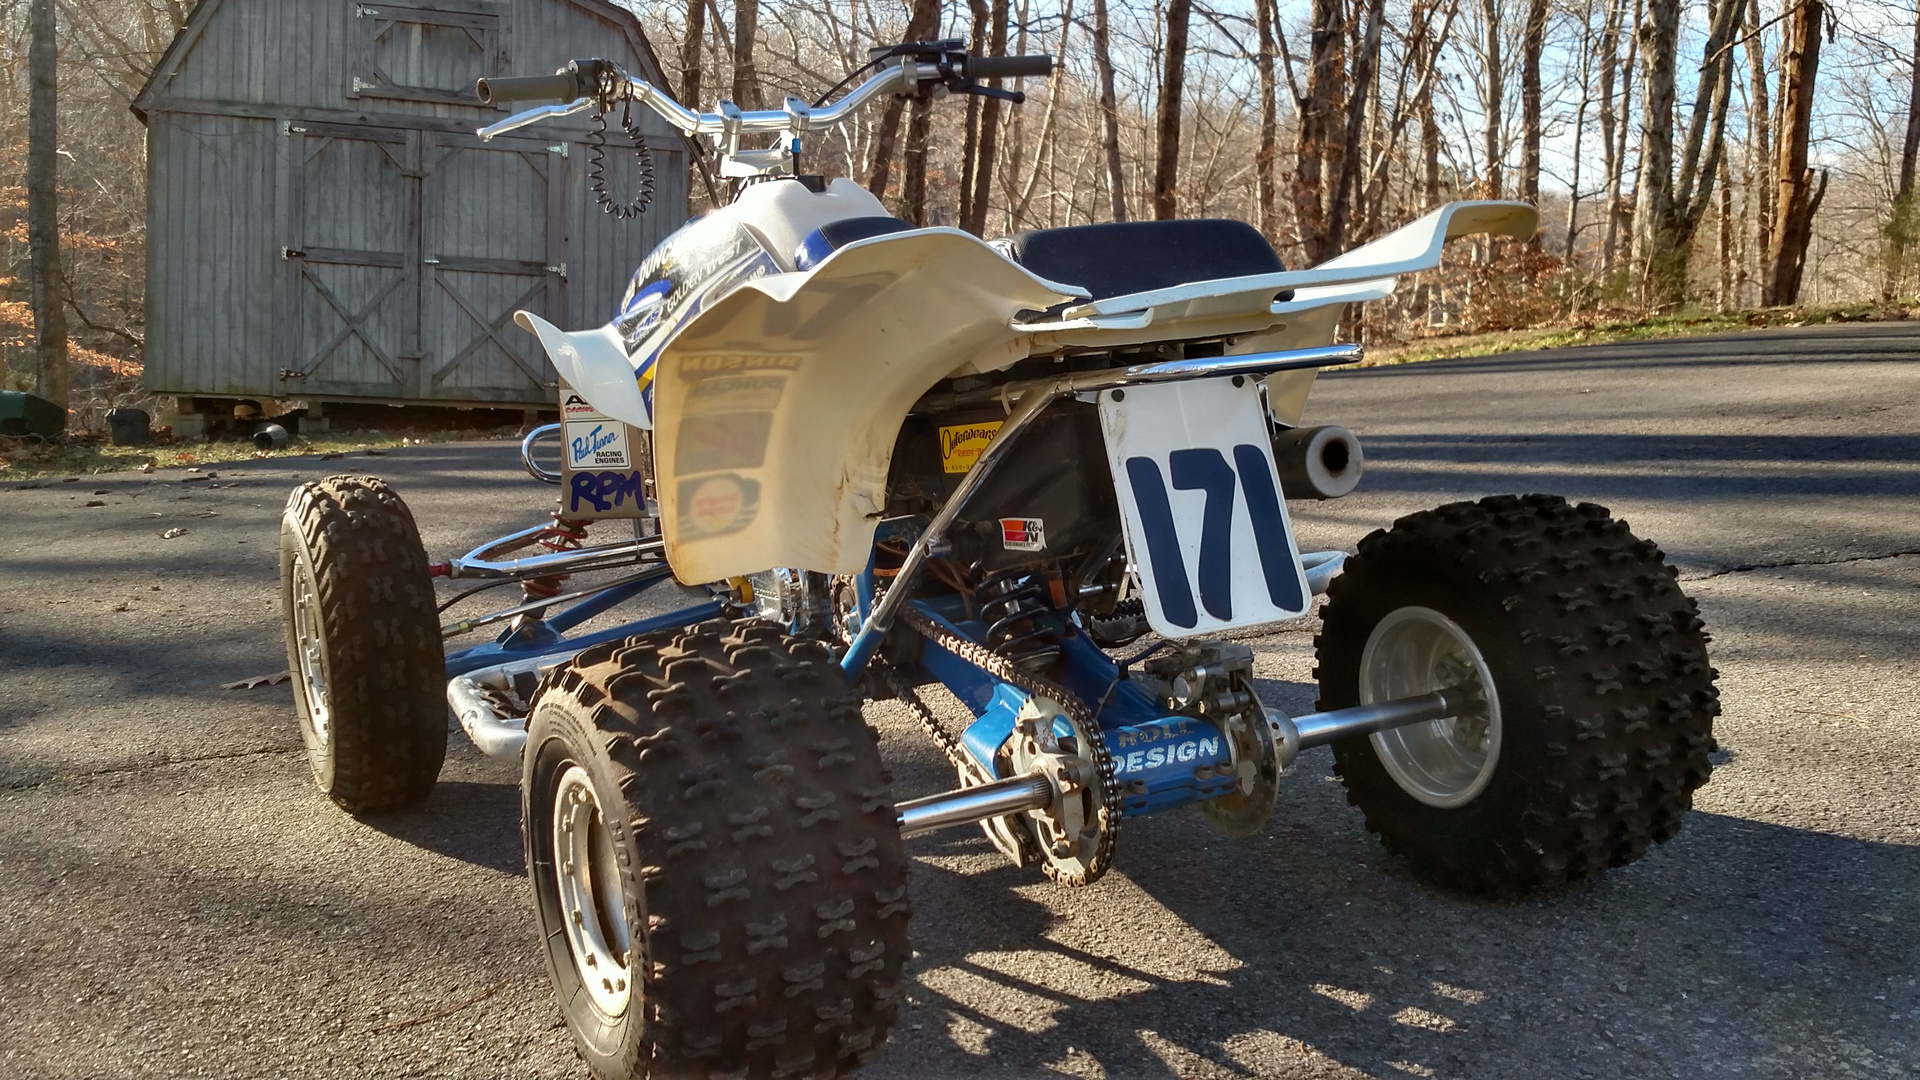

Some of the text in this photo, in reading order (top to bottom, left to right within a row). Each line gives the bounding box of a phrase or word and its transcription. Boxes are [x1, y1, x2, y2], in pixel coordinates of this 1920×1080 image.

[667, 272, 702, 312] GOLDEN
[942, 428, 997, 460] Outerwears
[570, 470, 646, 512] RPM
[1023, 520, 1043, 543] K&N
[1125, 443, 1304, 629] 171
[1110, 735, 1219, 776] DESIGN
